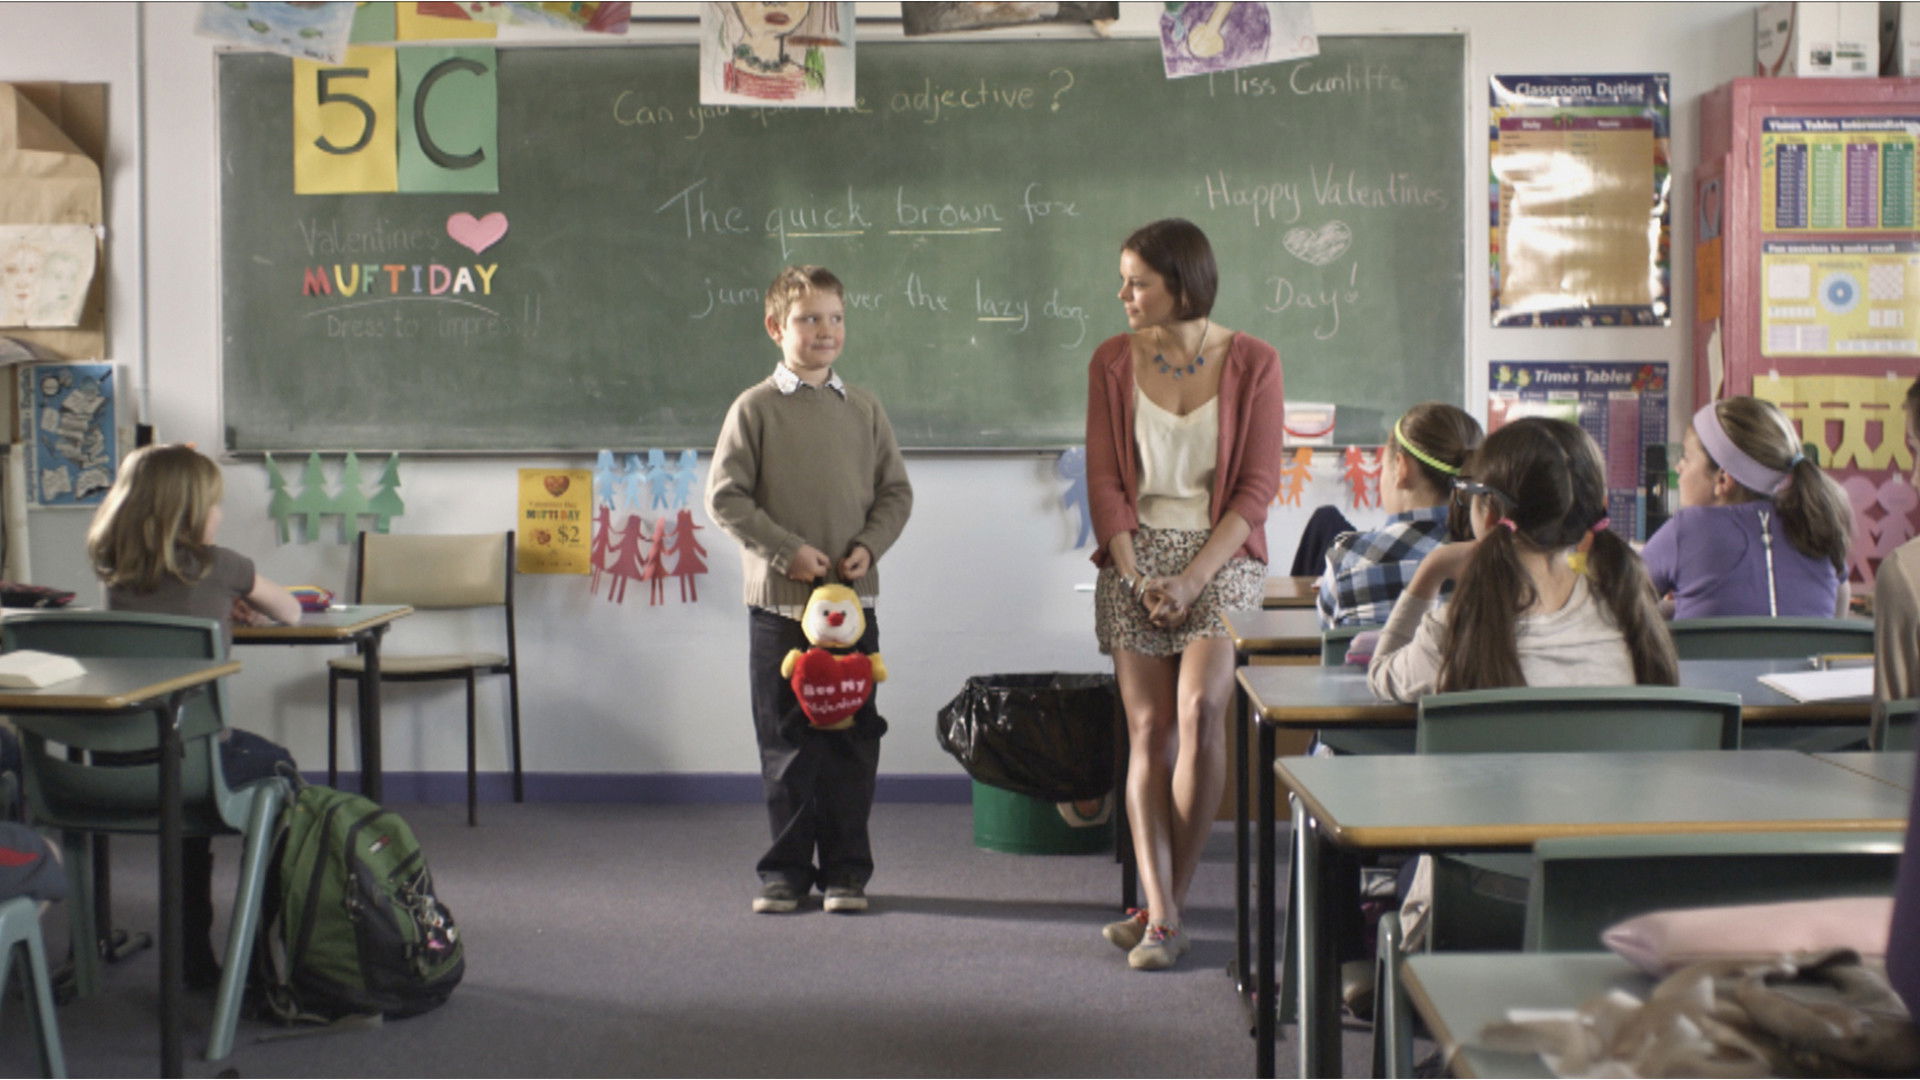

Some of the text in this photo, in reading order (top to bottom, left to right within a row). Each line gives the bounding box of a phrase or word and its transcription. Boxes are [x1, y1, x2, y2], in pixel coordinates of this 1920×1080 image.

[1515, 81, 1645, 97] Classroom Duties
[613, 90, 674, 126] Can
[1205, 162, 1449, 227] Happy Valentines
[655, 177, 1080, 261] The quick brown fox
[298, 218, 440, 257] Valentines
[689, 277, 760, 319] jum
[844, 290, 884, 311] ver
[905, 272, 950, 312] the
[975, 277, 1030, 333] lazy
[1264, 262, 1360, 340] Day!
[327, 314, 384, 339] Dress
[394, 304, 420, 338] to
[1534, 369, 1633, 383] Times Tables
[560, 510, 581, 521] DAY
[557, 524, 580, 544] $2
[803, 684, 836, 697] Bee
